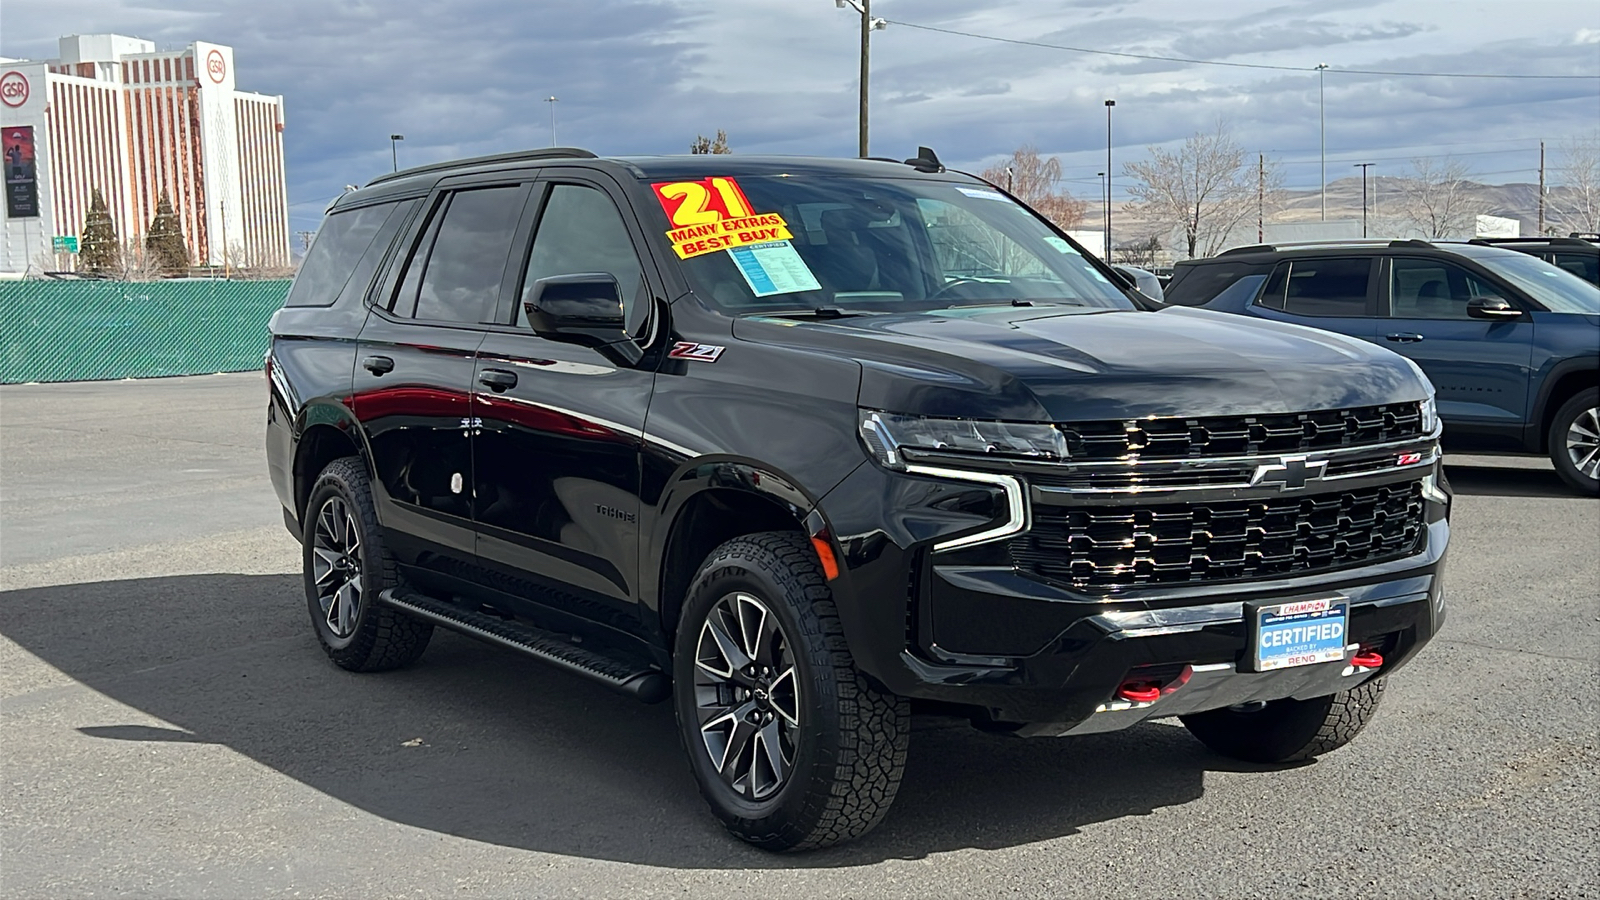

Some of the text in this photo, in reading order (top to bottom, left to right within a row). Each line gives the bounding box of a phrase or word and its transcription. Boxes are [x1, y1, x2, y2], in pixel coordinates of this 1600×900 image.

[210, 60, 224, 74] GSR
[3, 82, 25, 97] GSR
[659, 177, 750, 226] 21
[671, 215, 780, 242] MANY EXTRAS
[682, 228, 778, 255] BEST BUY
[594, 503, 636, 524] TAHOE
[1283, 601, 1327, 614] CHAMPION
[1261, 622, 1343, 648] CERTIFIED
[1286, 644, 1308, 653] BACKED
[1288, 654, 1316, 665] RENO
